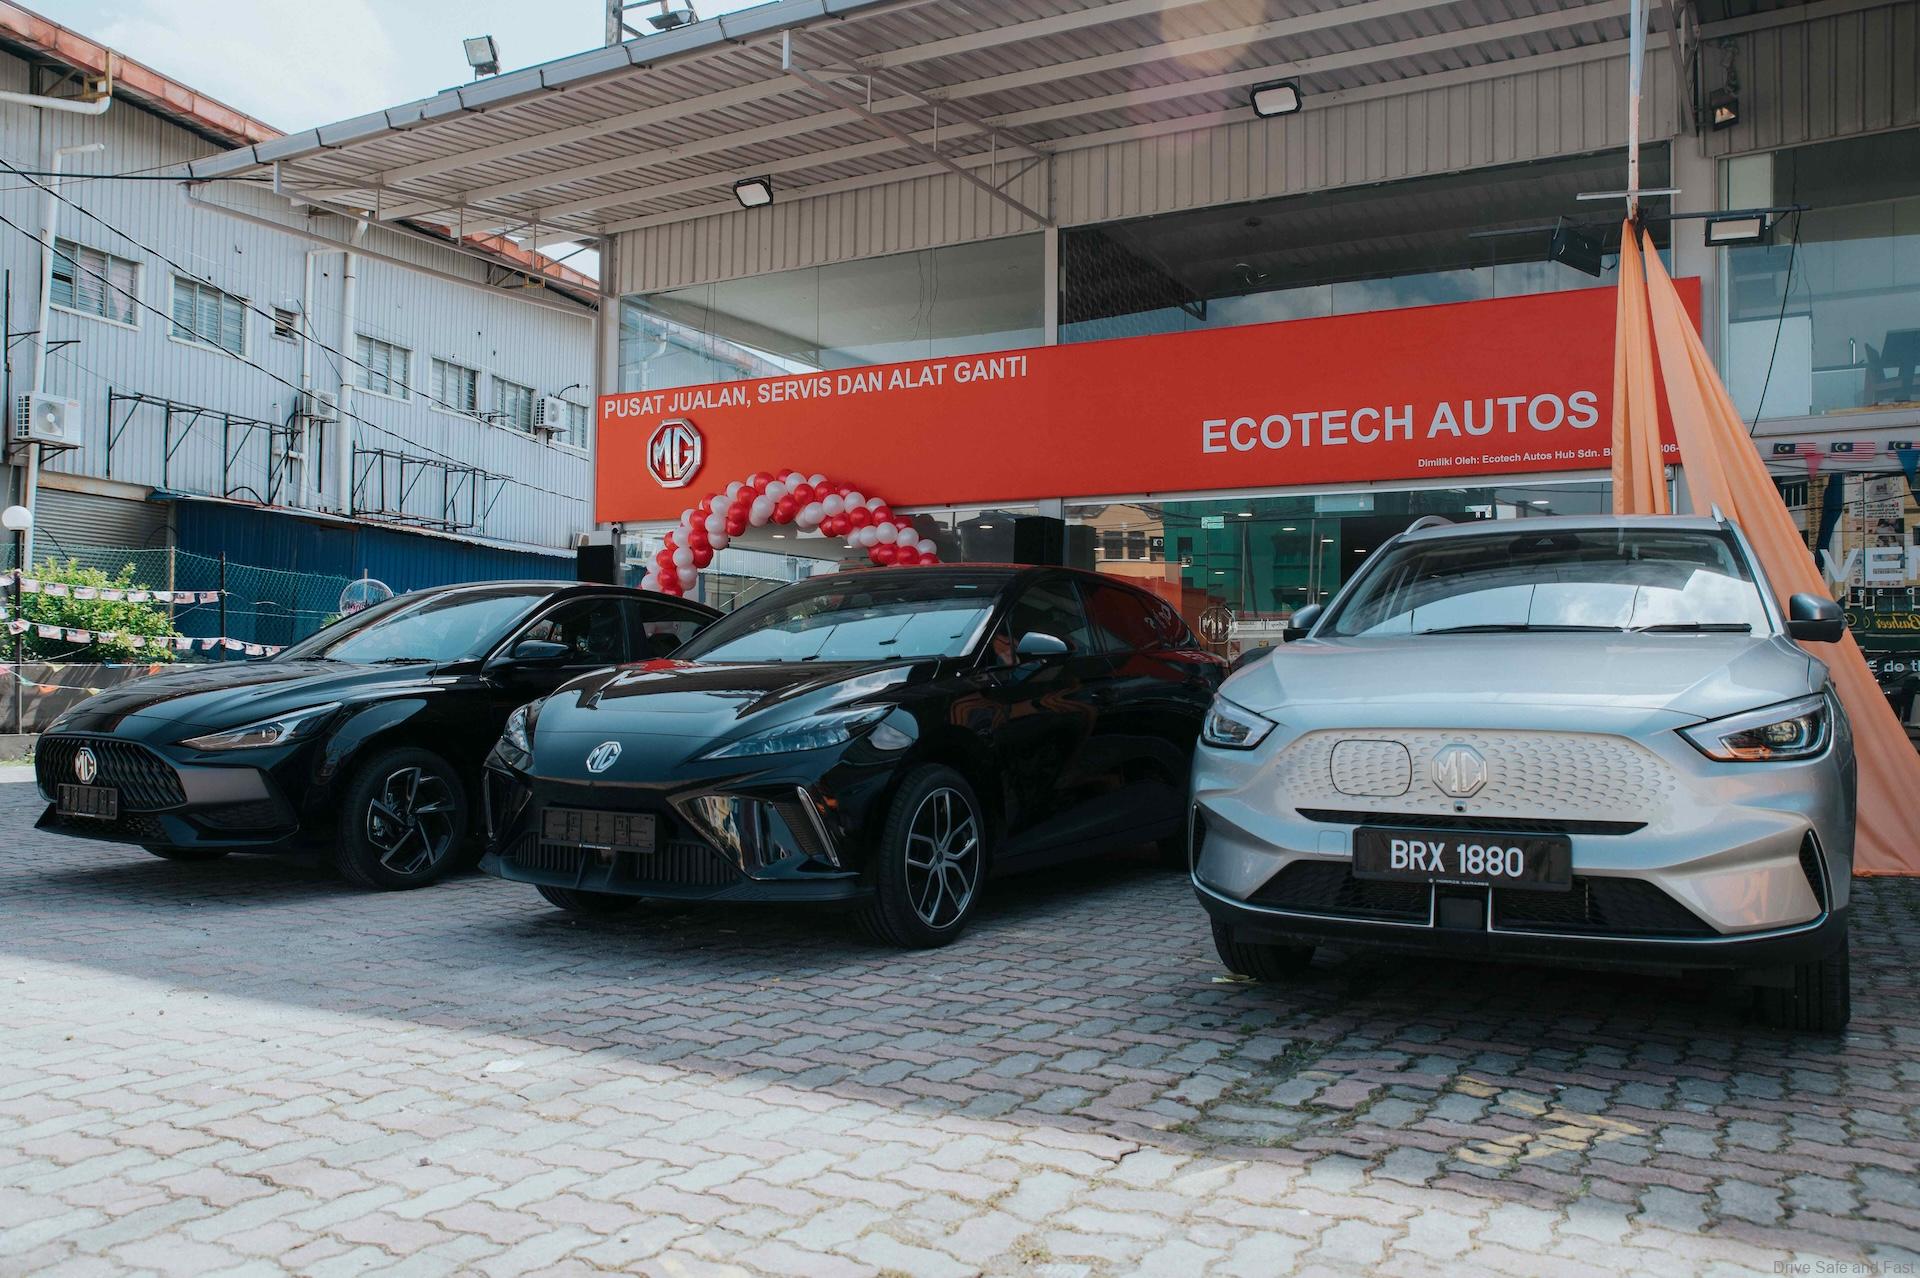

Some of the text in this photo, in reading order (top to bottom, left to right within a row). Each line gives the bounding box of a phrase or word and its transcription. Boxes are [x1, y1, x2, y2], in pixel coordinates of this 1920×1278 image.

[604, 355, 1027, 419] PUSAT JUALAN, SERVIS DAN ALAT GANTI
[1202, 390, 1599, 454] ECOTECH AUTOS
[651, 425, 696, 480] MG
[1418, 456, 1453, 468] Dimiliki
[1455, 455, 1480, 466] Oleh:
[1482, 453, 1521, 464] Ecotech
[1524, 450, 1552, 462] Autos
[1555, 449, 1575, 460] Hub
[1577, 447, 1601, 458] Sdn.
[75, 749, 96, 782] MG
[588, 743, 620, 771] MG
[1435, 749, 1483, 794] MG
[1390, 839, 1524, 878] BRX 1880
